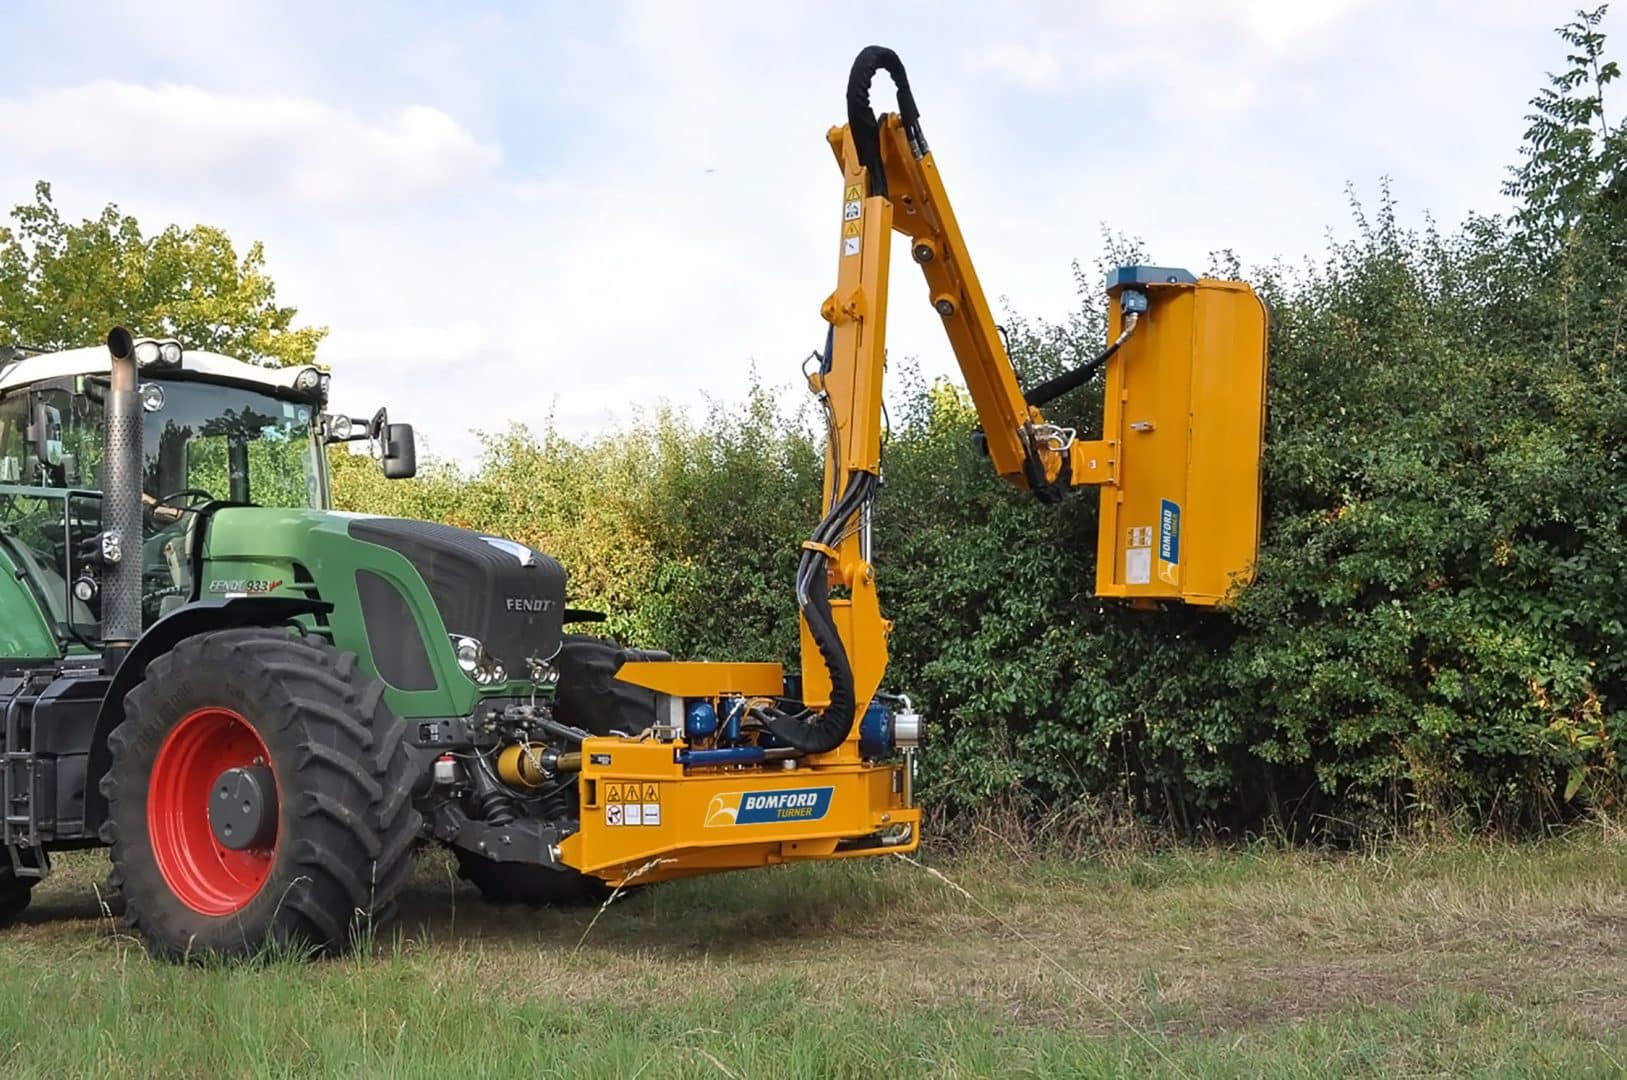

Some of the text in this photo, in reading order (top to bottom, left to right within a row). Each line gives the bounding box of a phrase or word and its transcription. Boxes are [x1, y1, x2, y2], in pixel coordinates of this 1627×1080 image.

[1162, 509, 1172, 558] BOMFORD
[209, 580, 245, 592] FENDT
[247, 580, 268, 592] 933
[506, 598, 552, 612] FENDT
[745, 792, 818, 810] BOMFORD
[776, 807, 813, 818] TURNER
